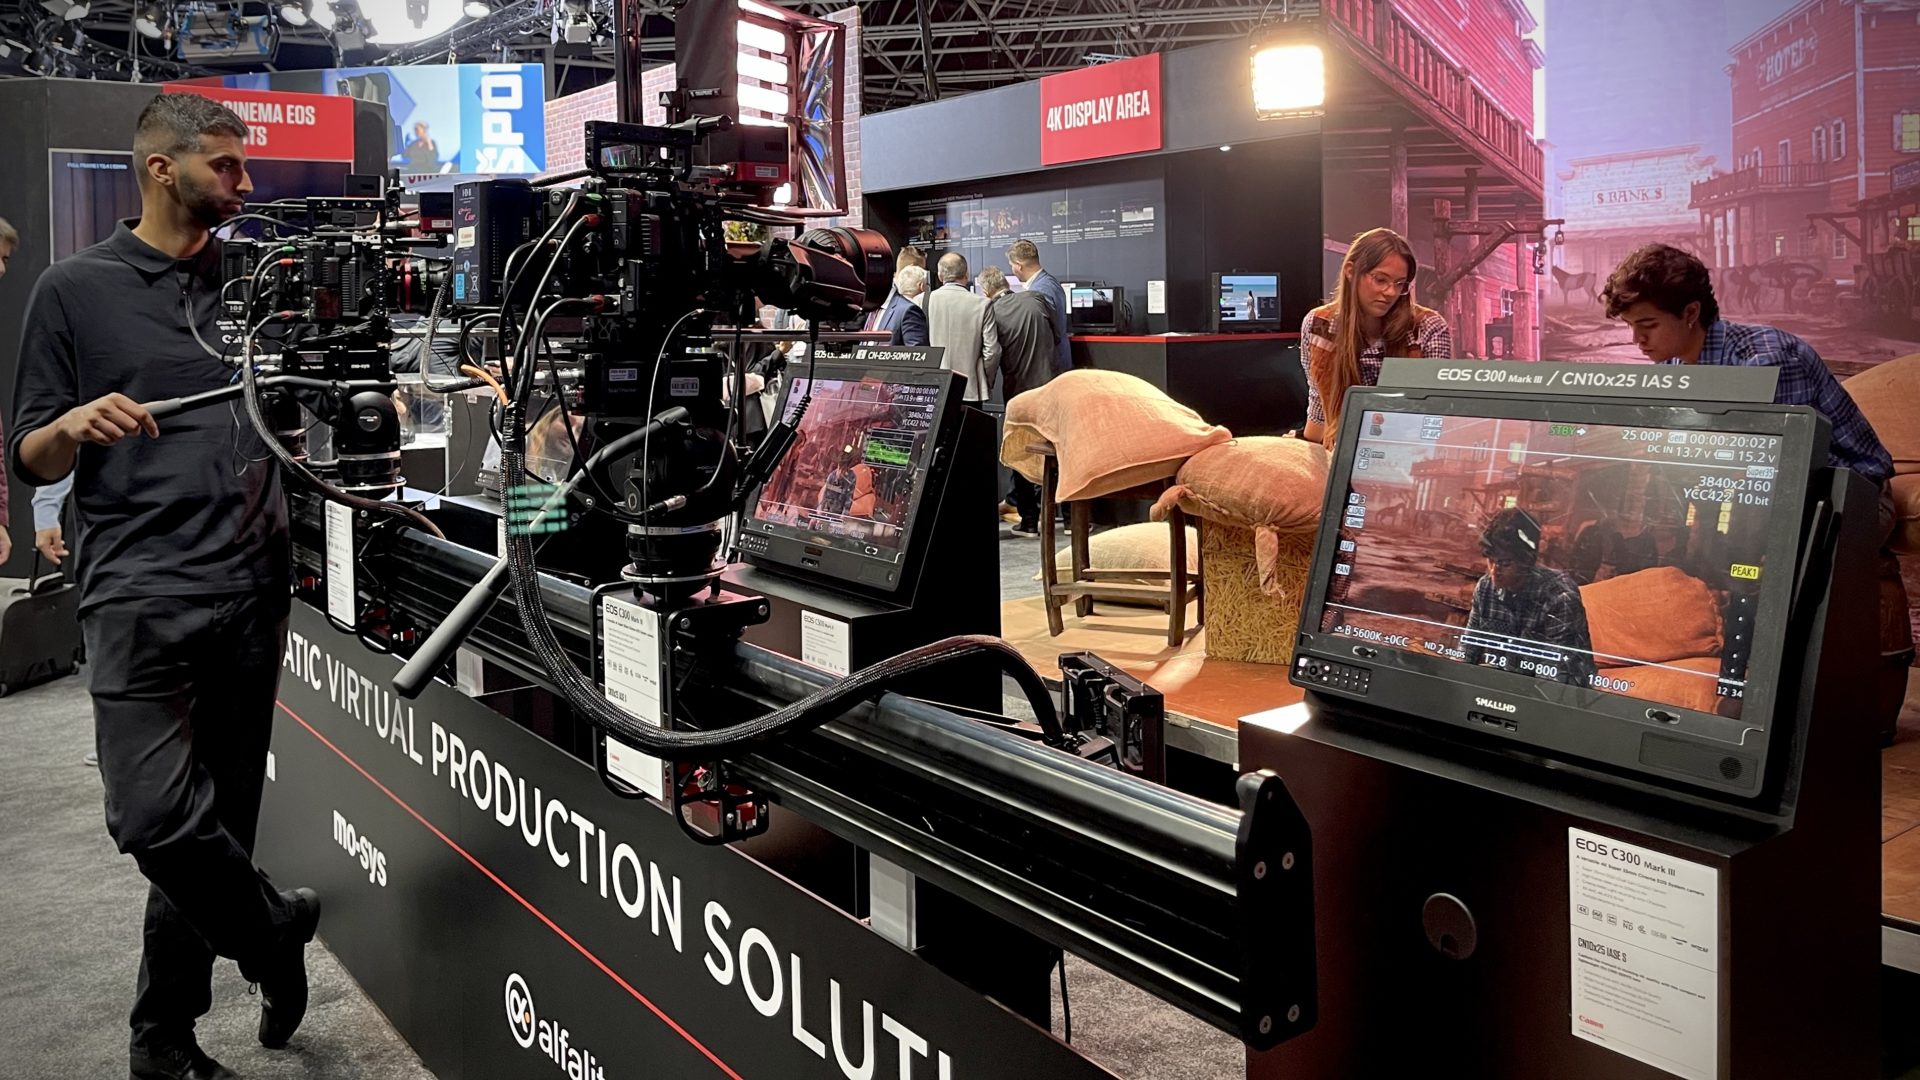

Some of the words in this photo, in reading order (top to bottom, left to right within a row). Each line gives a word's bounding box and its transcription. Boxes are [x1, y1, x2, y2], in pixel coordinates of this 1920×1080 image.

[1766, 38, 1804, 82] HOTEL
[286, 104, 316, 125] EOS
[475, 64, 524, 173] ŠPO
[1046, 106, 1062, 132] 4K
[1064, 96, 1114, 129] DISPLAY
[1116, 90, 1150, 120] AREA
[242, 125, 267, 146] TS
[1608, 189, 1649, 203] BANK
[912, 353, 926, 361] T2.4
[1437, 368, 1472, 381] EOS
[1474, 370, 1506, 382] C300
[1508, 374, 1532, 383] Mark
[1533, 376, 1543, 384] III
[1562, 372, 1637, 387] CN10x25
[1641, 374, 1672, 388] IAS
[1678, 375, 1690, 389] S
[1550, 424, 1576, 436] STBY
[1622, 429, 1663, 441] 25.00P
[1690, 434, 1766, 449] 00:00:20:02
[1768, 438, 1777, 449] P
[1647, 445, 1660, 453] DC
[1663, 446, 1674, 454] IN
[1676, 447, 1700, 458] 13.7
[1738, 452, 1765, 463] 15.2
[1699, 476, 1771, 492] 3840x2160
[1683, 488, 1732, 503] YCC422
[1738, 492, 1752, 505] 10
[1754, 495, 1769, 506] bit
[1341, 541, 1354, 551] LUT
[1336, 564, 1350, 574] FAN
[1732, 566, 1757, 578] PEAK1
[605, 604, 618, 616] EOS
[1345, 625, 1352, 635] B
[1353, 626, 1381, 641] 5600K
[1384, 634, 1409, 648] ±0CC
[1424, 641, 1436, 650] ND
[1437, 644, 1444, 654] 2
[1445, 648, 1466, 659] stops
[1484, 653, 1507, 667] T2.8
[1520, 660, 1535, 671] ISO
[1536, 664, 1558, 678] 800
[1717, 686, 1728, 695] 12
[1731, 689, 1743, 698] 34
[1475, 697, 1516, 713] SMALLHD
[283, 630, 322, 690] ATIC
[326, 653, 423, 765] VIRTUAL
[432, 722, 682, 953] PRODUCTION
[704, 901, 950, 1080] SOLUT
[333, 809, 387, 887] mo-sys
[1576, 838, 1608, 856] EOS
[1611, 848, 1641, 866] C300
[1644, 861, 1666, 874] Mark
[1578, 937, 1605, 955] CN10x25
[1607, 945, 1621, 961] IASE
[1622, 952, 1627, 962] S
